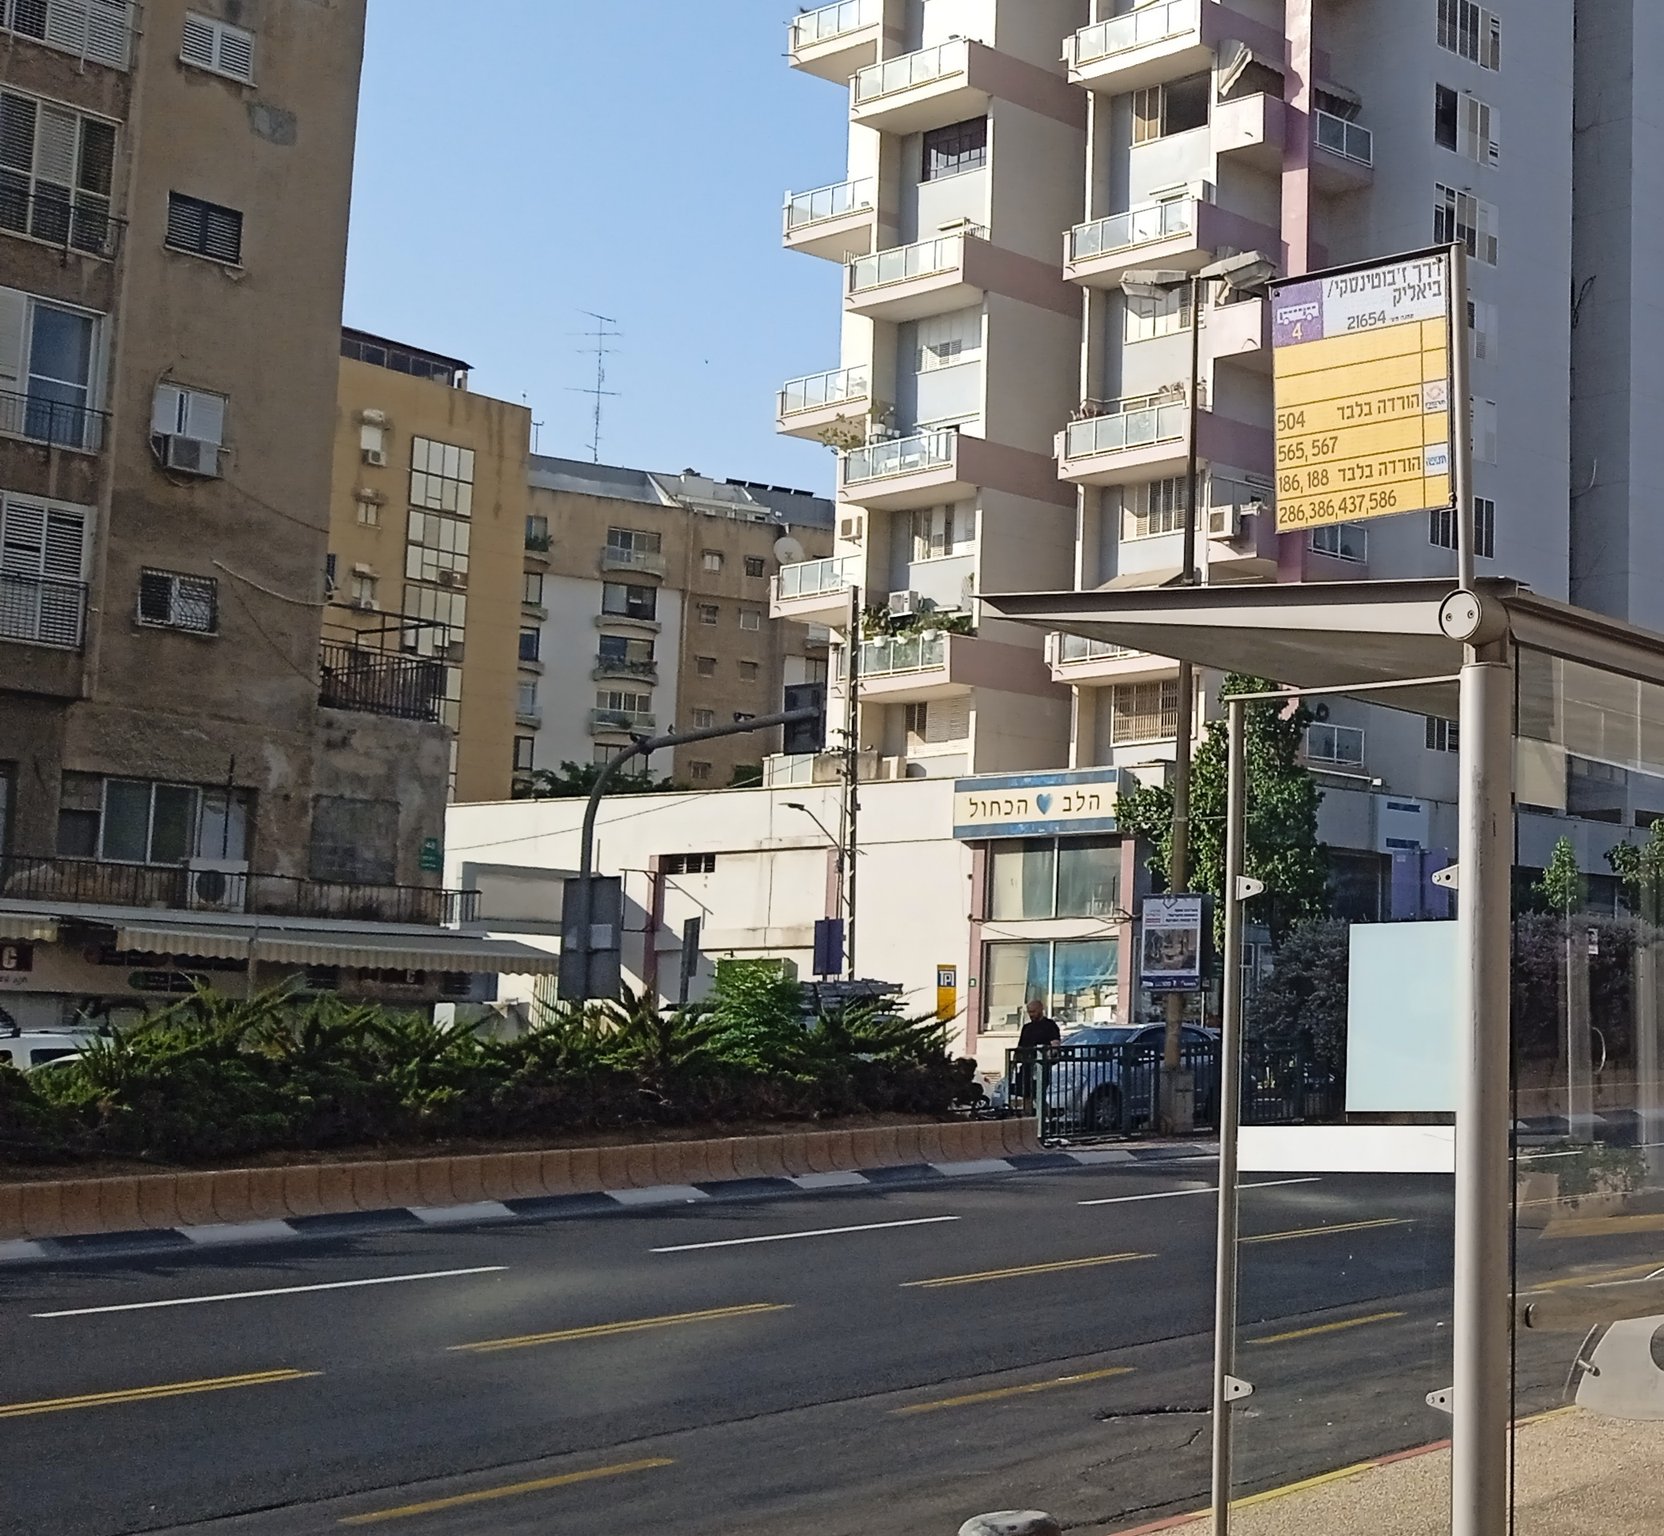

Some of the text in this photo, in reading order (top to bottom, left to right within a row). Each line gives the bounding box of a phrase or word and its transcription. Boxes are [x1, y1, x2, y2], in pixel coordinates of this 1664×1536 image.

[1414, 261, 1441, 282] דרך
[1392, 279, 1442, 307] ביאליק
[1347, 310, 1387, 330] 21654
[1291, 323, 1303, 340] 4
[1337, 399, 1373, 421] בלבד
[1378, 392, 1421, 414] הורדה
[1277, 410, 1306, 432] 504
[1278, 436, 1339, 463] 565, 567
[1278, 454, 1421, 493] הורדה בלבד 186, 188
[969, 791, 1101, 818] הלב הכחול
